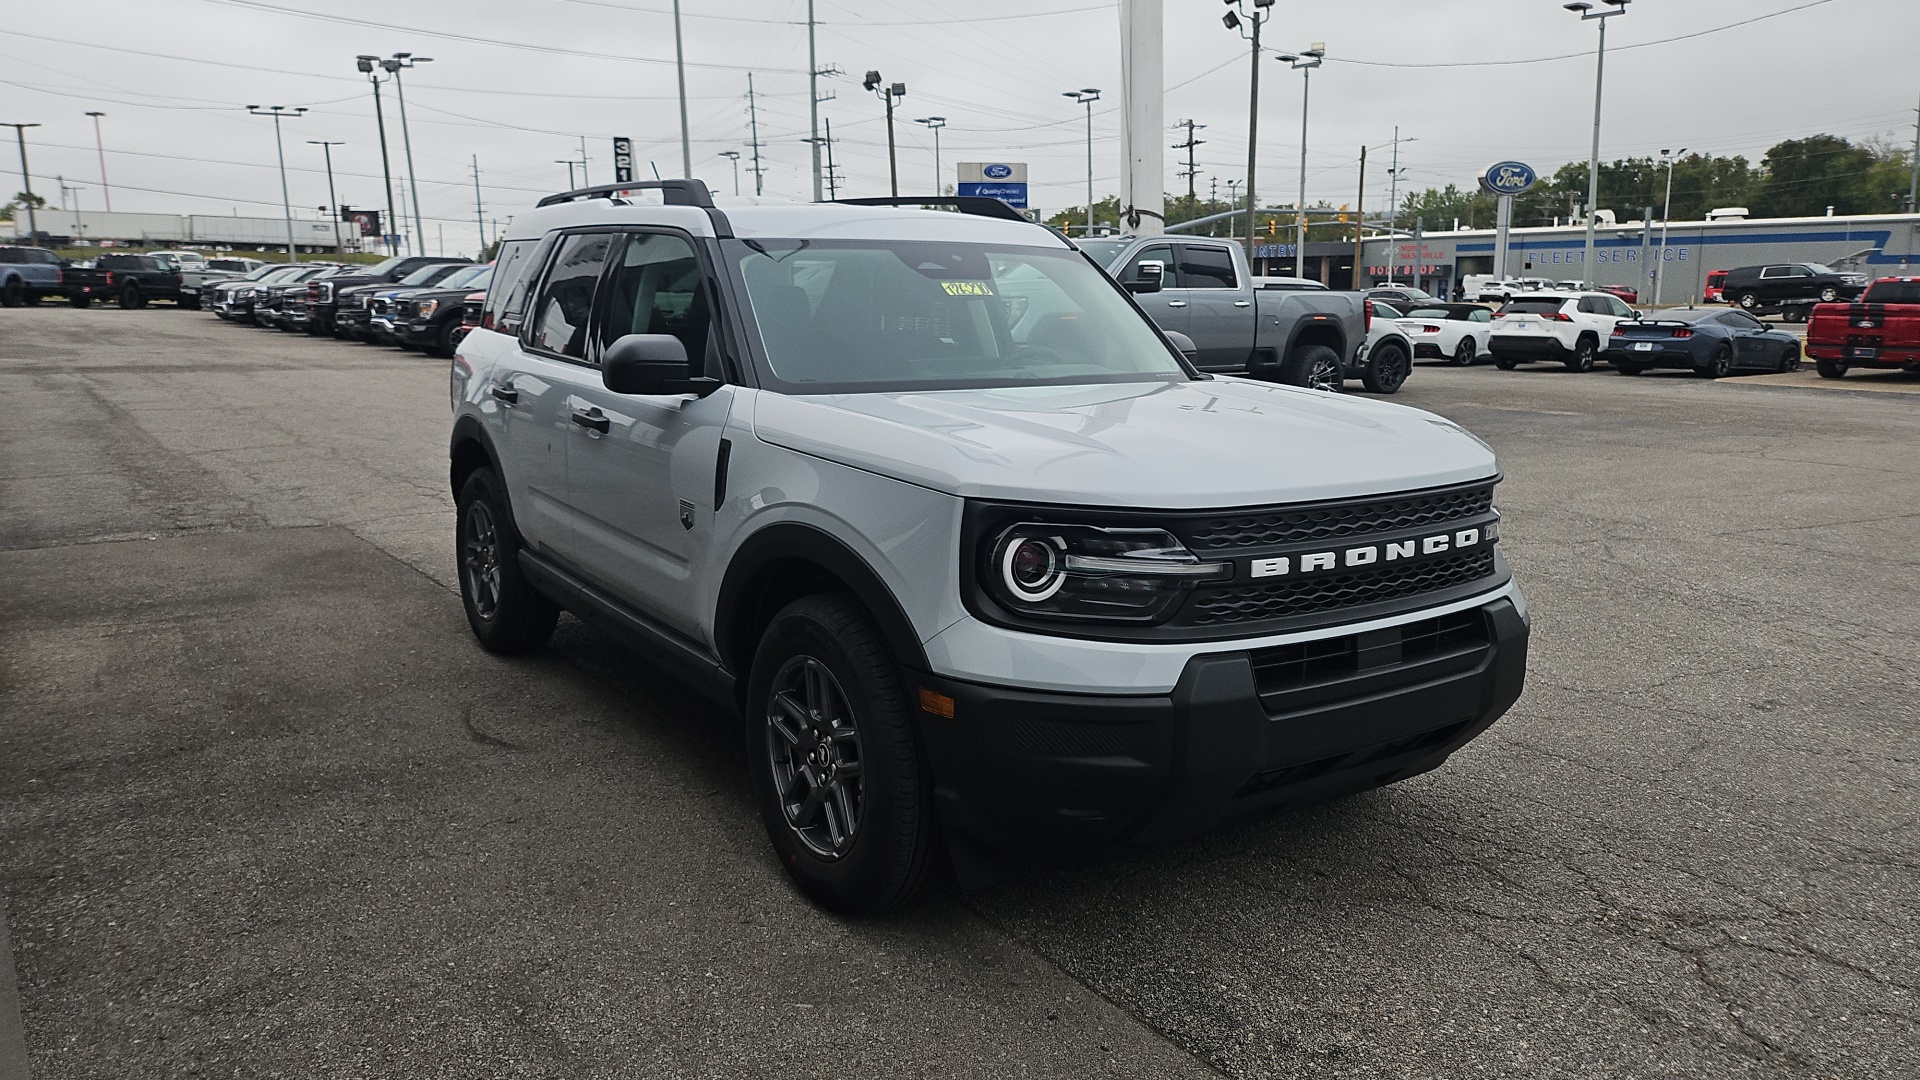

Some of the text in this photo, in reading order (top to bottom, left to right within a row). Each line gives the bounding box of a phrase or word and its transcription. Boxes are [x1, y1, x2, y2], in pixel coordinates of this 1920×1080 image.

[616, 141, 631, 182] 321
[1496, 167, 1528, 187] Ford
[1243, 244, 1297, 258] UNTRY
[1400, 251, 1445, 259] NASVILLE
[1528, 248, 1689, 264] FLEET SERICE
[1369, 266, 1399, 275] BODY
[1250, 528, 1479, 578] BRONCO
